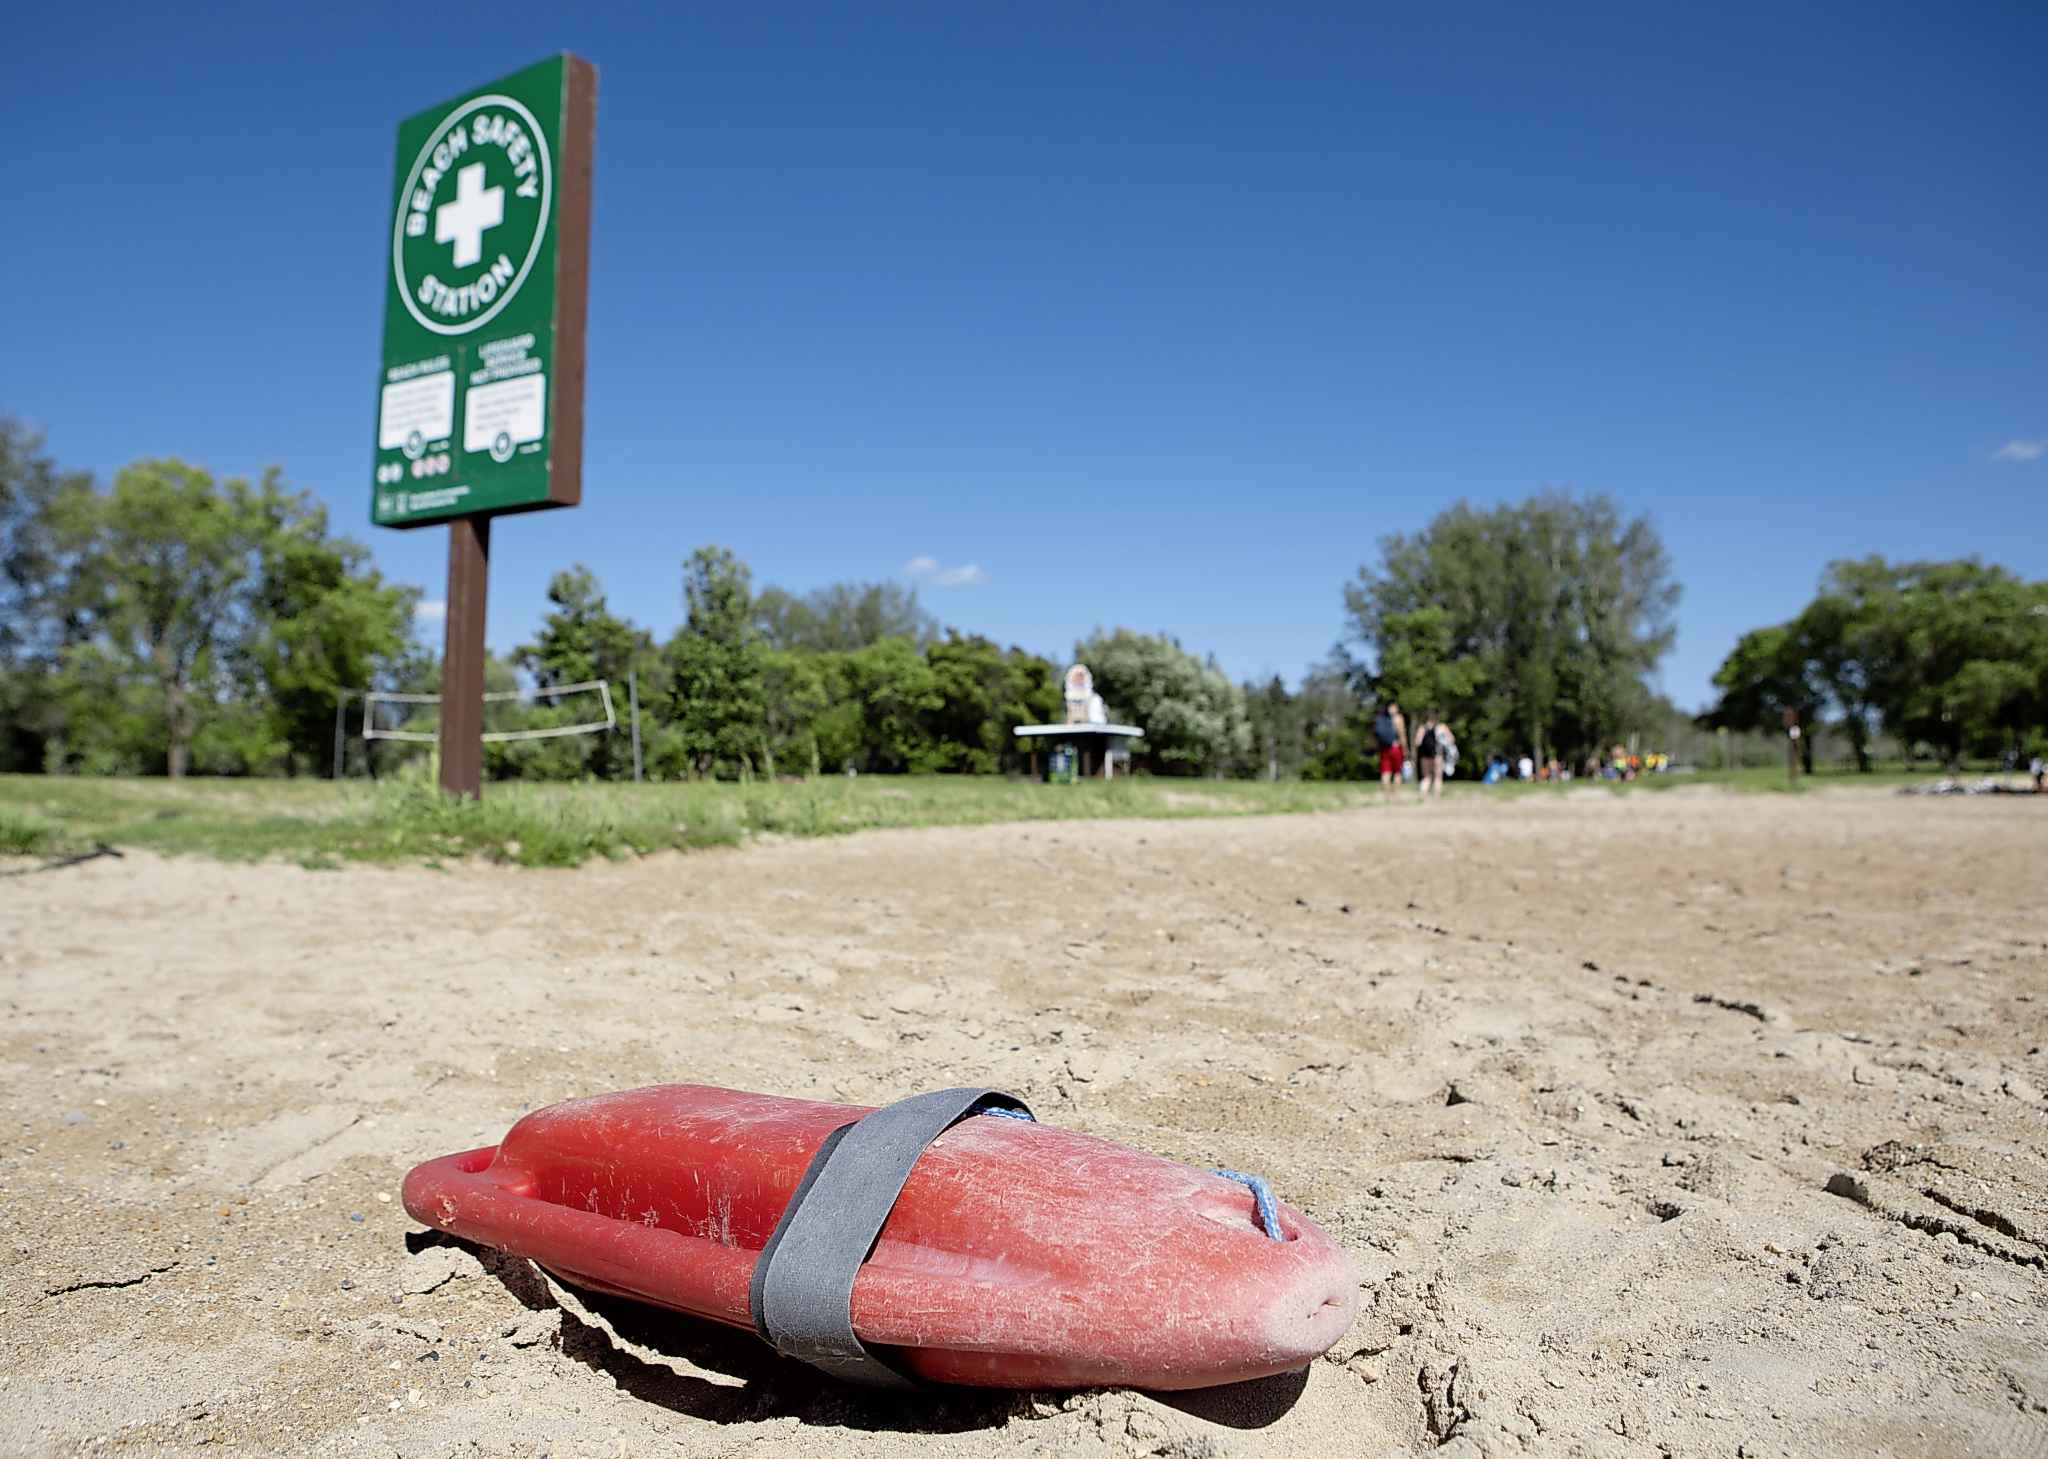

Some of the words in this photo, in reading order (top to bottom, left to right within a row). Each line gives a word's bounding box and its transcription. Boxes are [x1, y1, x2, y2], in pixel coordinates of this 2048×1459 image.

[406, 124, 468, 237] BEACH
[472, 114, 538, 198] SAFETY
[418, 254, 514, 317] STATION
